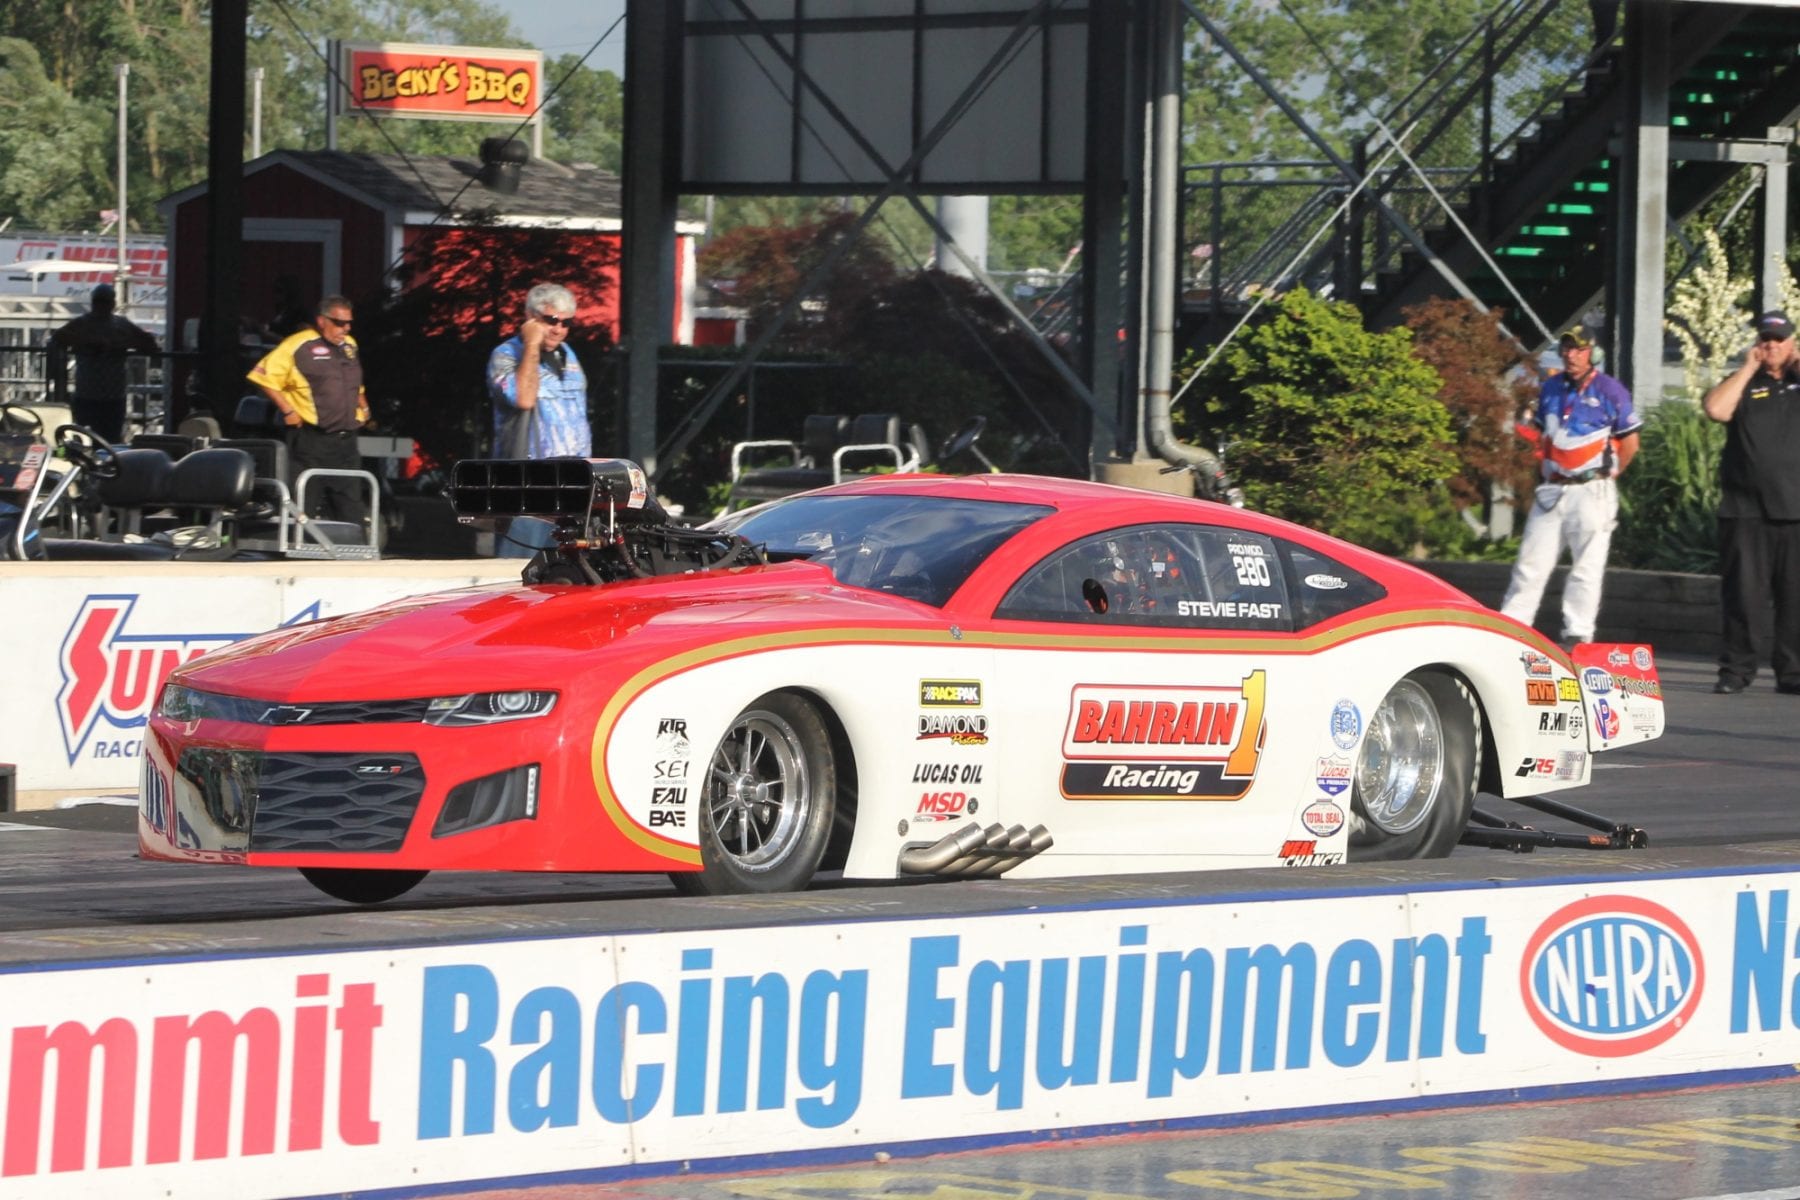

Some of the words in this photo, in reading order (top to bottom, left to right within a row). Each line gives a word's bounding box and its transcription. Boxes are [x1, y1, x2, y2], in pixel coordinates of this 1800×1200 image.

[361, 59, 461, 102] BECKY'S
[466, 62, 532, 107] BBQ
[1233, 556, 1271, 587] 280
[1178, 601, 1237, 617] STEVIE
[1238, 603, 1282, 619] FAST
[656, 718, 689, 741] KTR
[918, 715, 988, 735] DIAMOND
[1072, 700, 1239, 745] BAHRAIN
[1225, 669, 1266, 776] 1
[912, 764, 959, 784] LUCAS
[961, 764, 983, 784] OIL
[1102, 765, 1200, 793] Racing
[1321, 767, 1350, 778] LUCAS
[917, 792, 966, 813] MSD
[649, 811, 686, 827] BAE
[1306, 813, 1324, 824] TOTAL
[1325, 813, 1341, 824] SEAL
[1730, 888, 1800, 1034] N
[1545, 921, 1684, 1029] NHRA
[1, 973, 382, 1177] mmit
[416, 948, 869, 1141] Racing
[900, 916, 1491, 1111] Equipment
